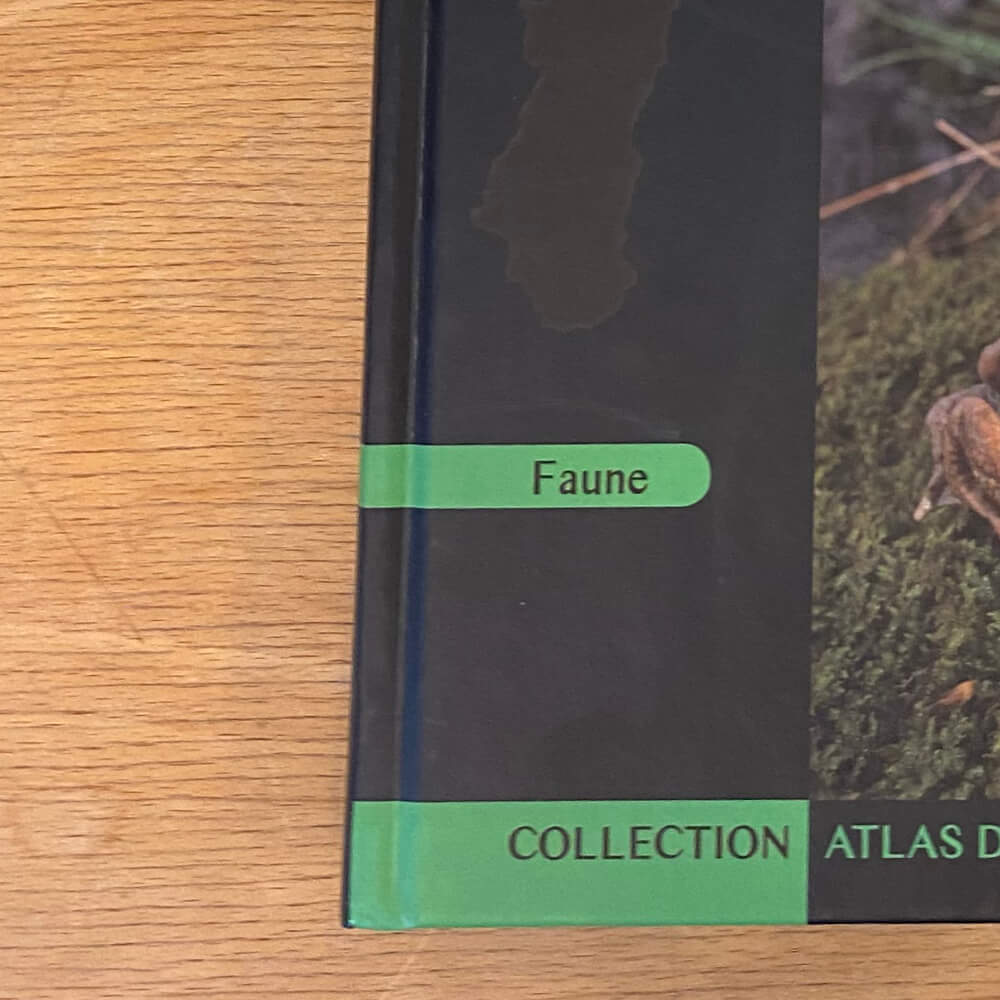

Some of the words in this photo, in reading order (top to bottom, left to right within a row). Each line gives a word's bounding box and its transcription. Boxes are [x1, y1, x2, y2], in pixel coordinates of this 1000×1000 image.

[533, 460, 648, 495] Faune
[508, 824, 789, 861] COLLECTION
[825, 823, 964, 859] ATLAS
